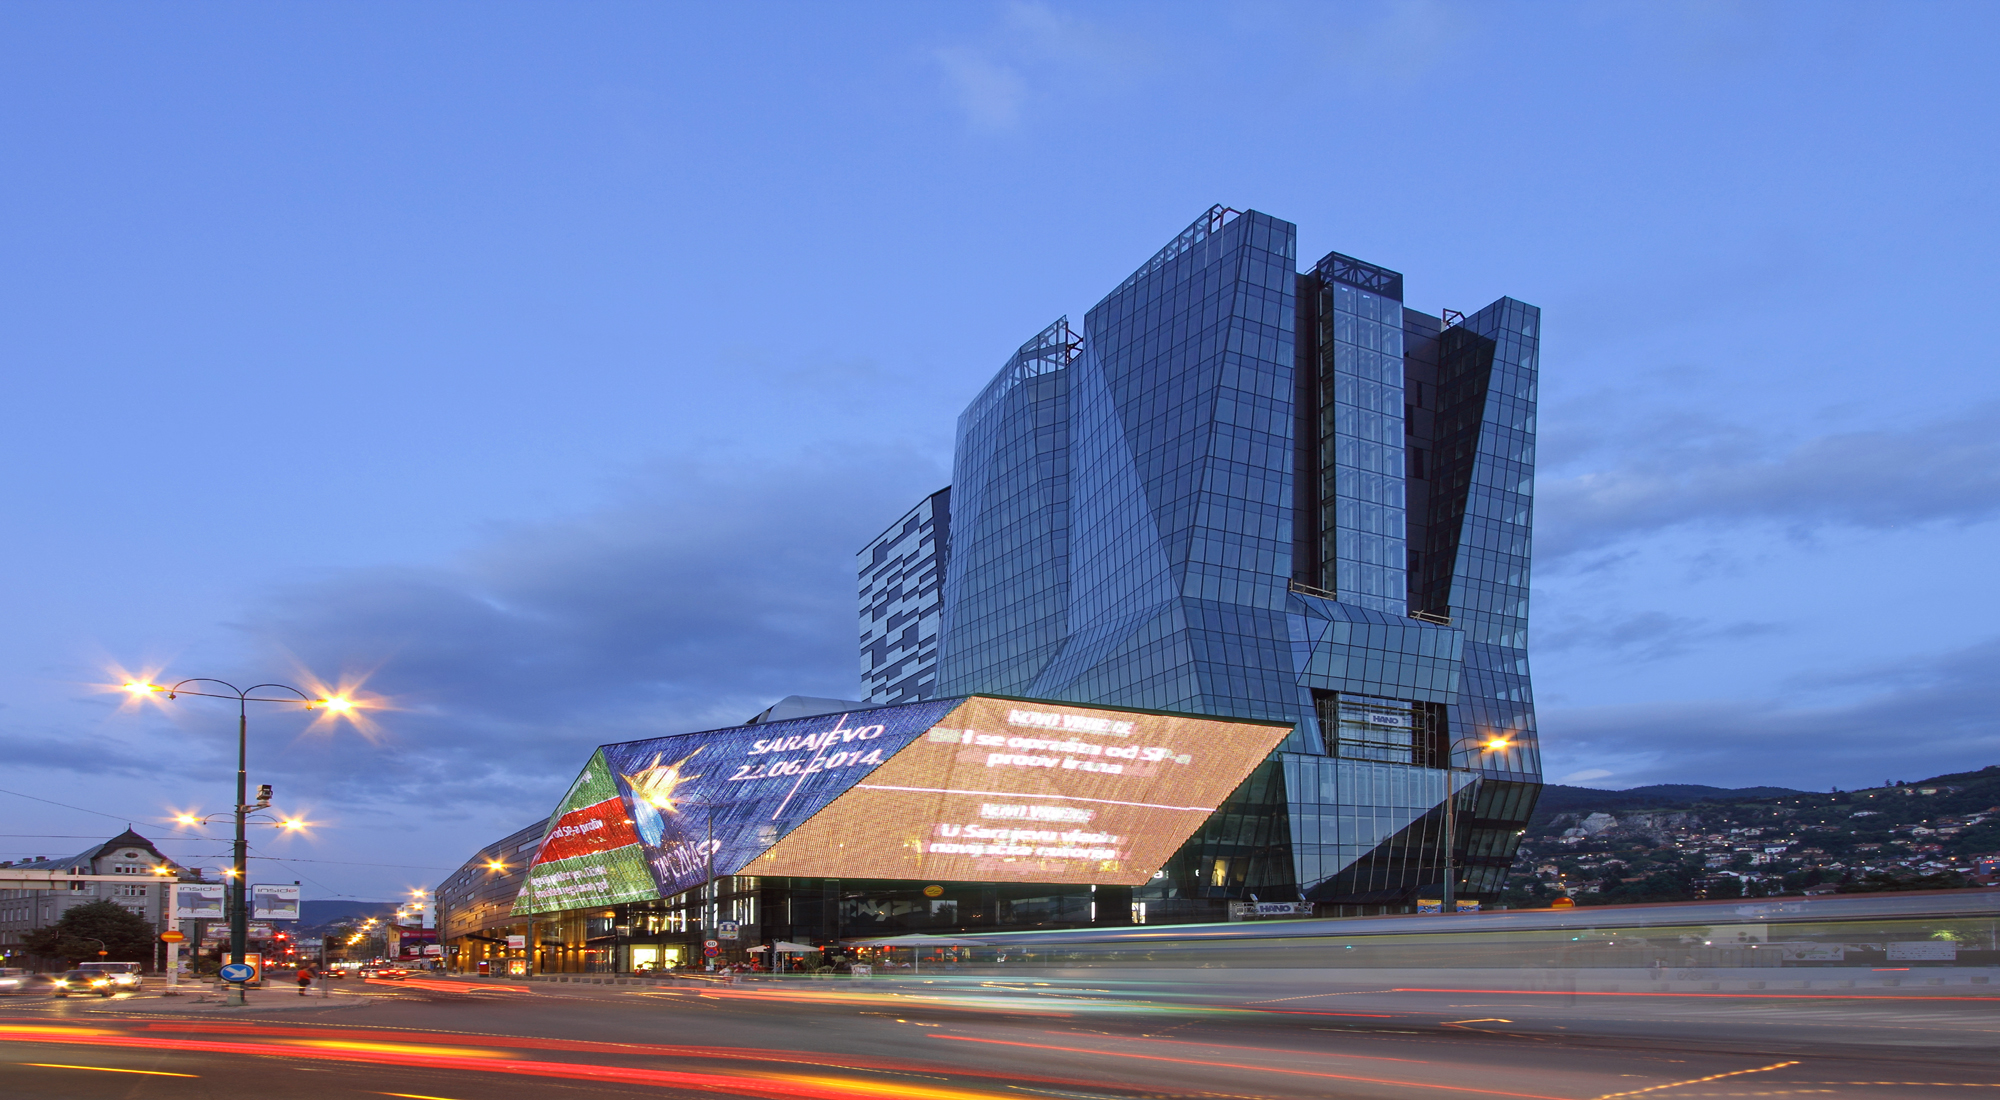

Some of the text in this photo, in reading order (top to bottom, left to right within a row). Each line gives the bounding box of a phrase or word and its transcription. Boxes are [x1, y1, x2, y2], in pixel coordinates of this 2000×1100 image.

[1372, 715, 1399, 724] HANO
[747, 724, 885, 755] SARAJEVO
[1105, 745, 1139, 759] od
